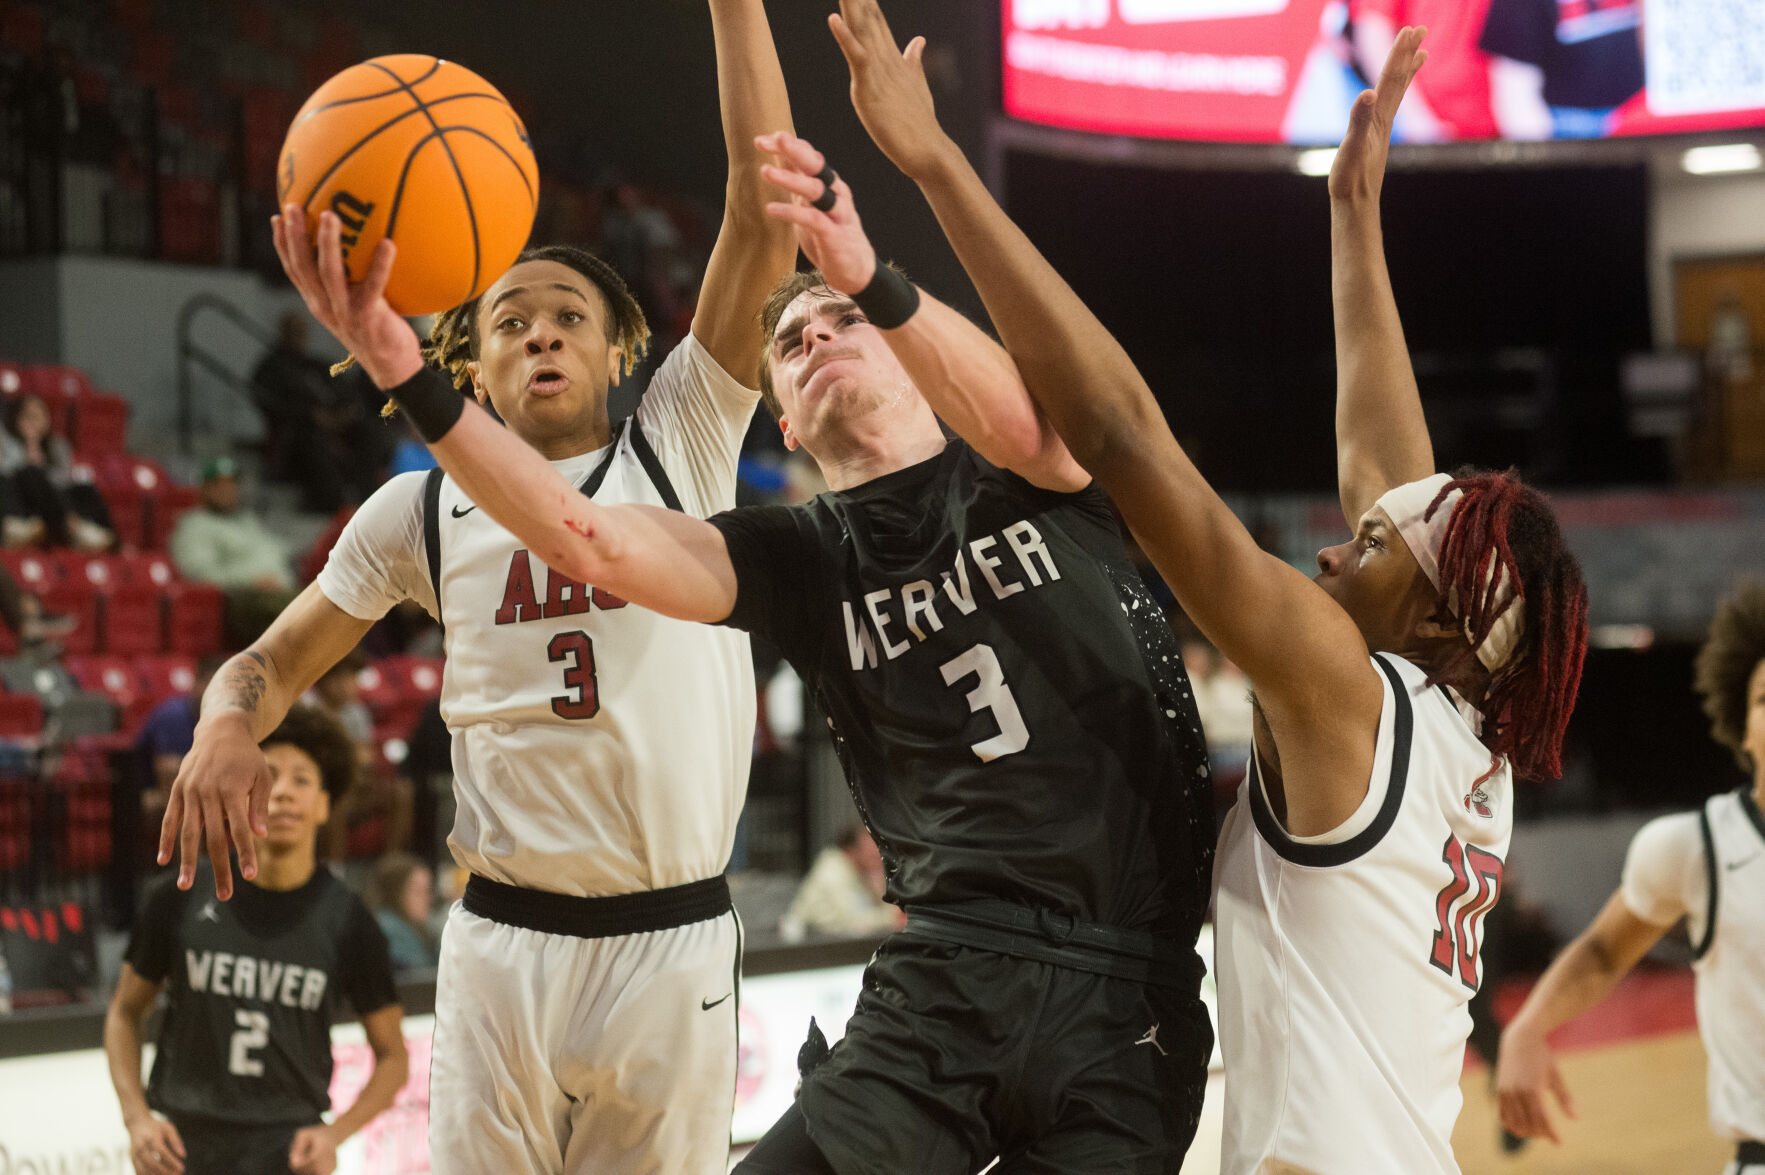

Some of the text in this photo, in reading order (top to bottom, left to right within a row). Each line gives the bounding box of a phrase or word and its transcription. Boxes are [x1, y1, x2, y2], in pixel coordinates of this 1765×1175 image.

[495, 549, 629, 625] AH
[842, 519, 1062, 671] WEAVER
[546, 630, 600, 720] 3
[938, 643, 1030, 764] 3
[1429, 831, 1504, 993] 10
[185, 948, 328, 1011] WEAVER
[228, 1008, 270, 1078] 2
